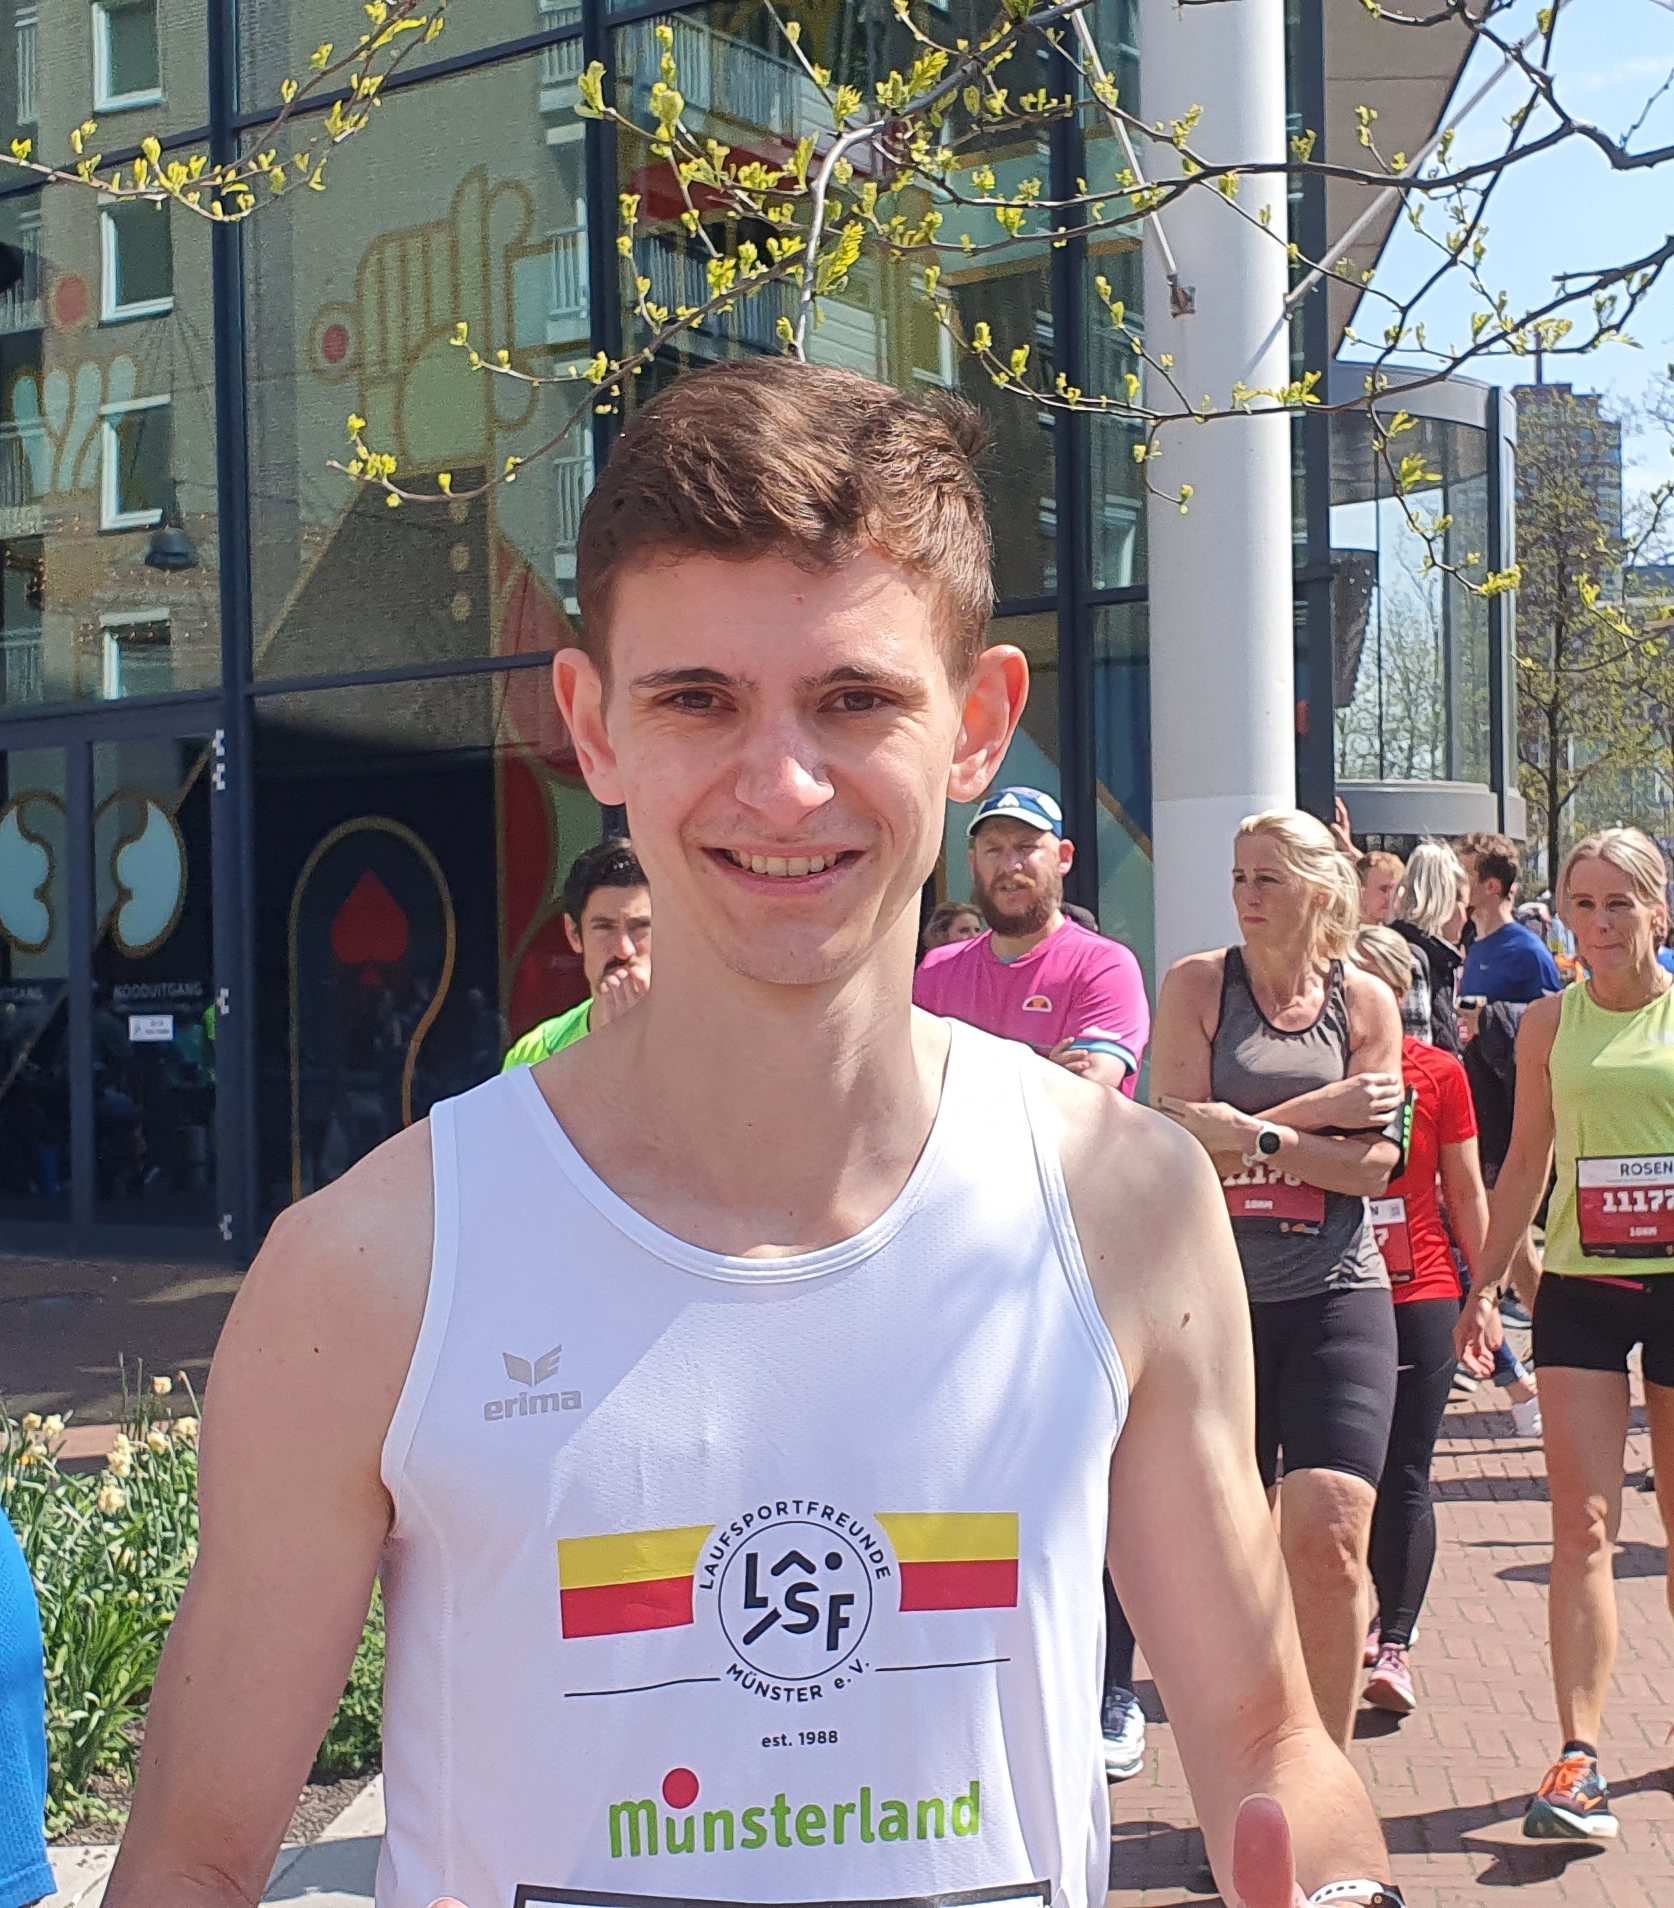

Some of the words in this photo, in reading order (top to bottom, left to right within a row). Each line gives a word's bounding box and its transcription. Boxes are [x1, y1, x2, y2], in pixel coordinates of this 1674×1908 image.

[1620, 1161, 1673, 1177] ROSEN
[484, 1390, 582, 1422] erima
[699, 1499, 891, 1590] LAUFSPORTFREUNDE
[743, 1552, 855, 1651] LSF
[726, 1662, 824, 1703] MÜNSTER
[761, 1734, 793, 1748] est.
[798, 1730, 838, 1746] 1988
